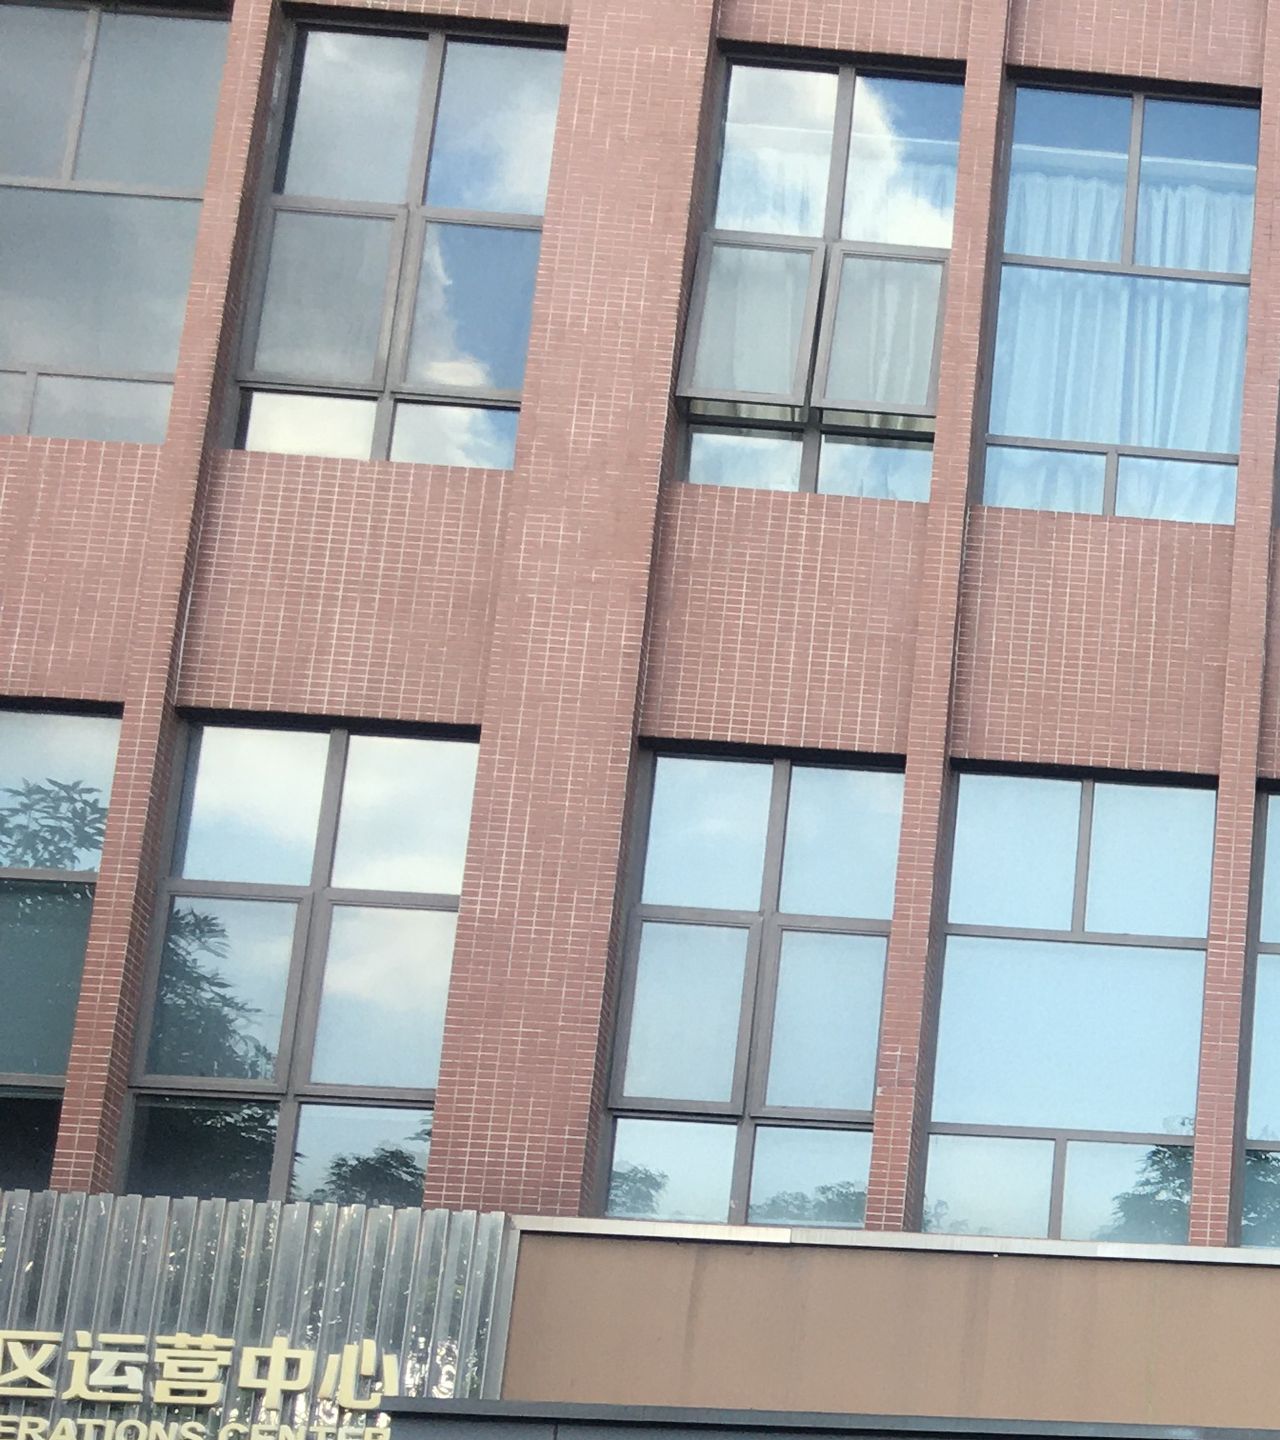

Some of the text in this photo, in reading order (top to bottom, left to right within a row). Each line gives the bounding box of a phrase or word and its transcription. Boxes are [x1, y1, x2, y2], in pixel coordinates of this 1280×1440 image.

[0, 1329, 399, 1410] 区运营中心
